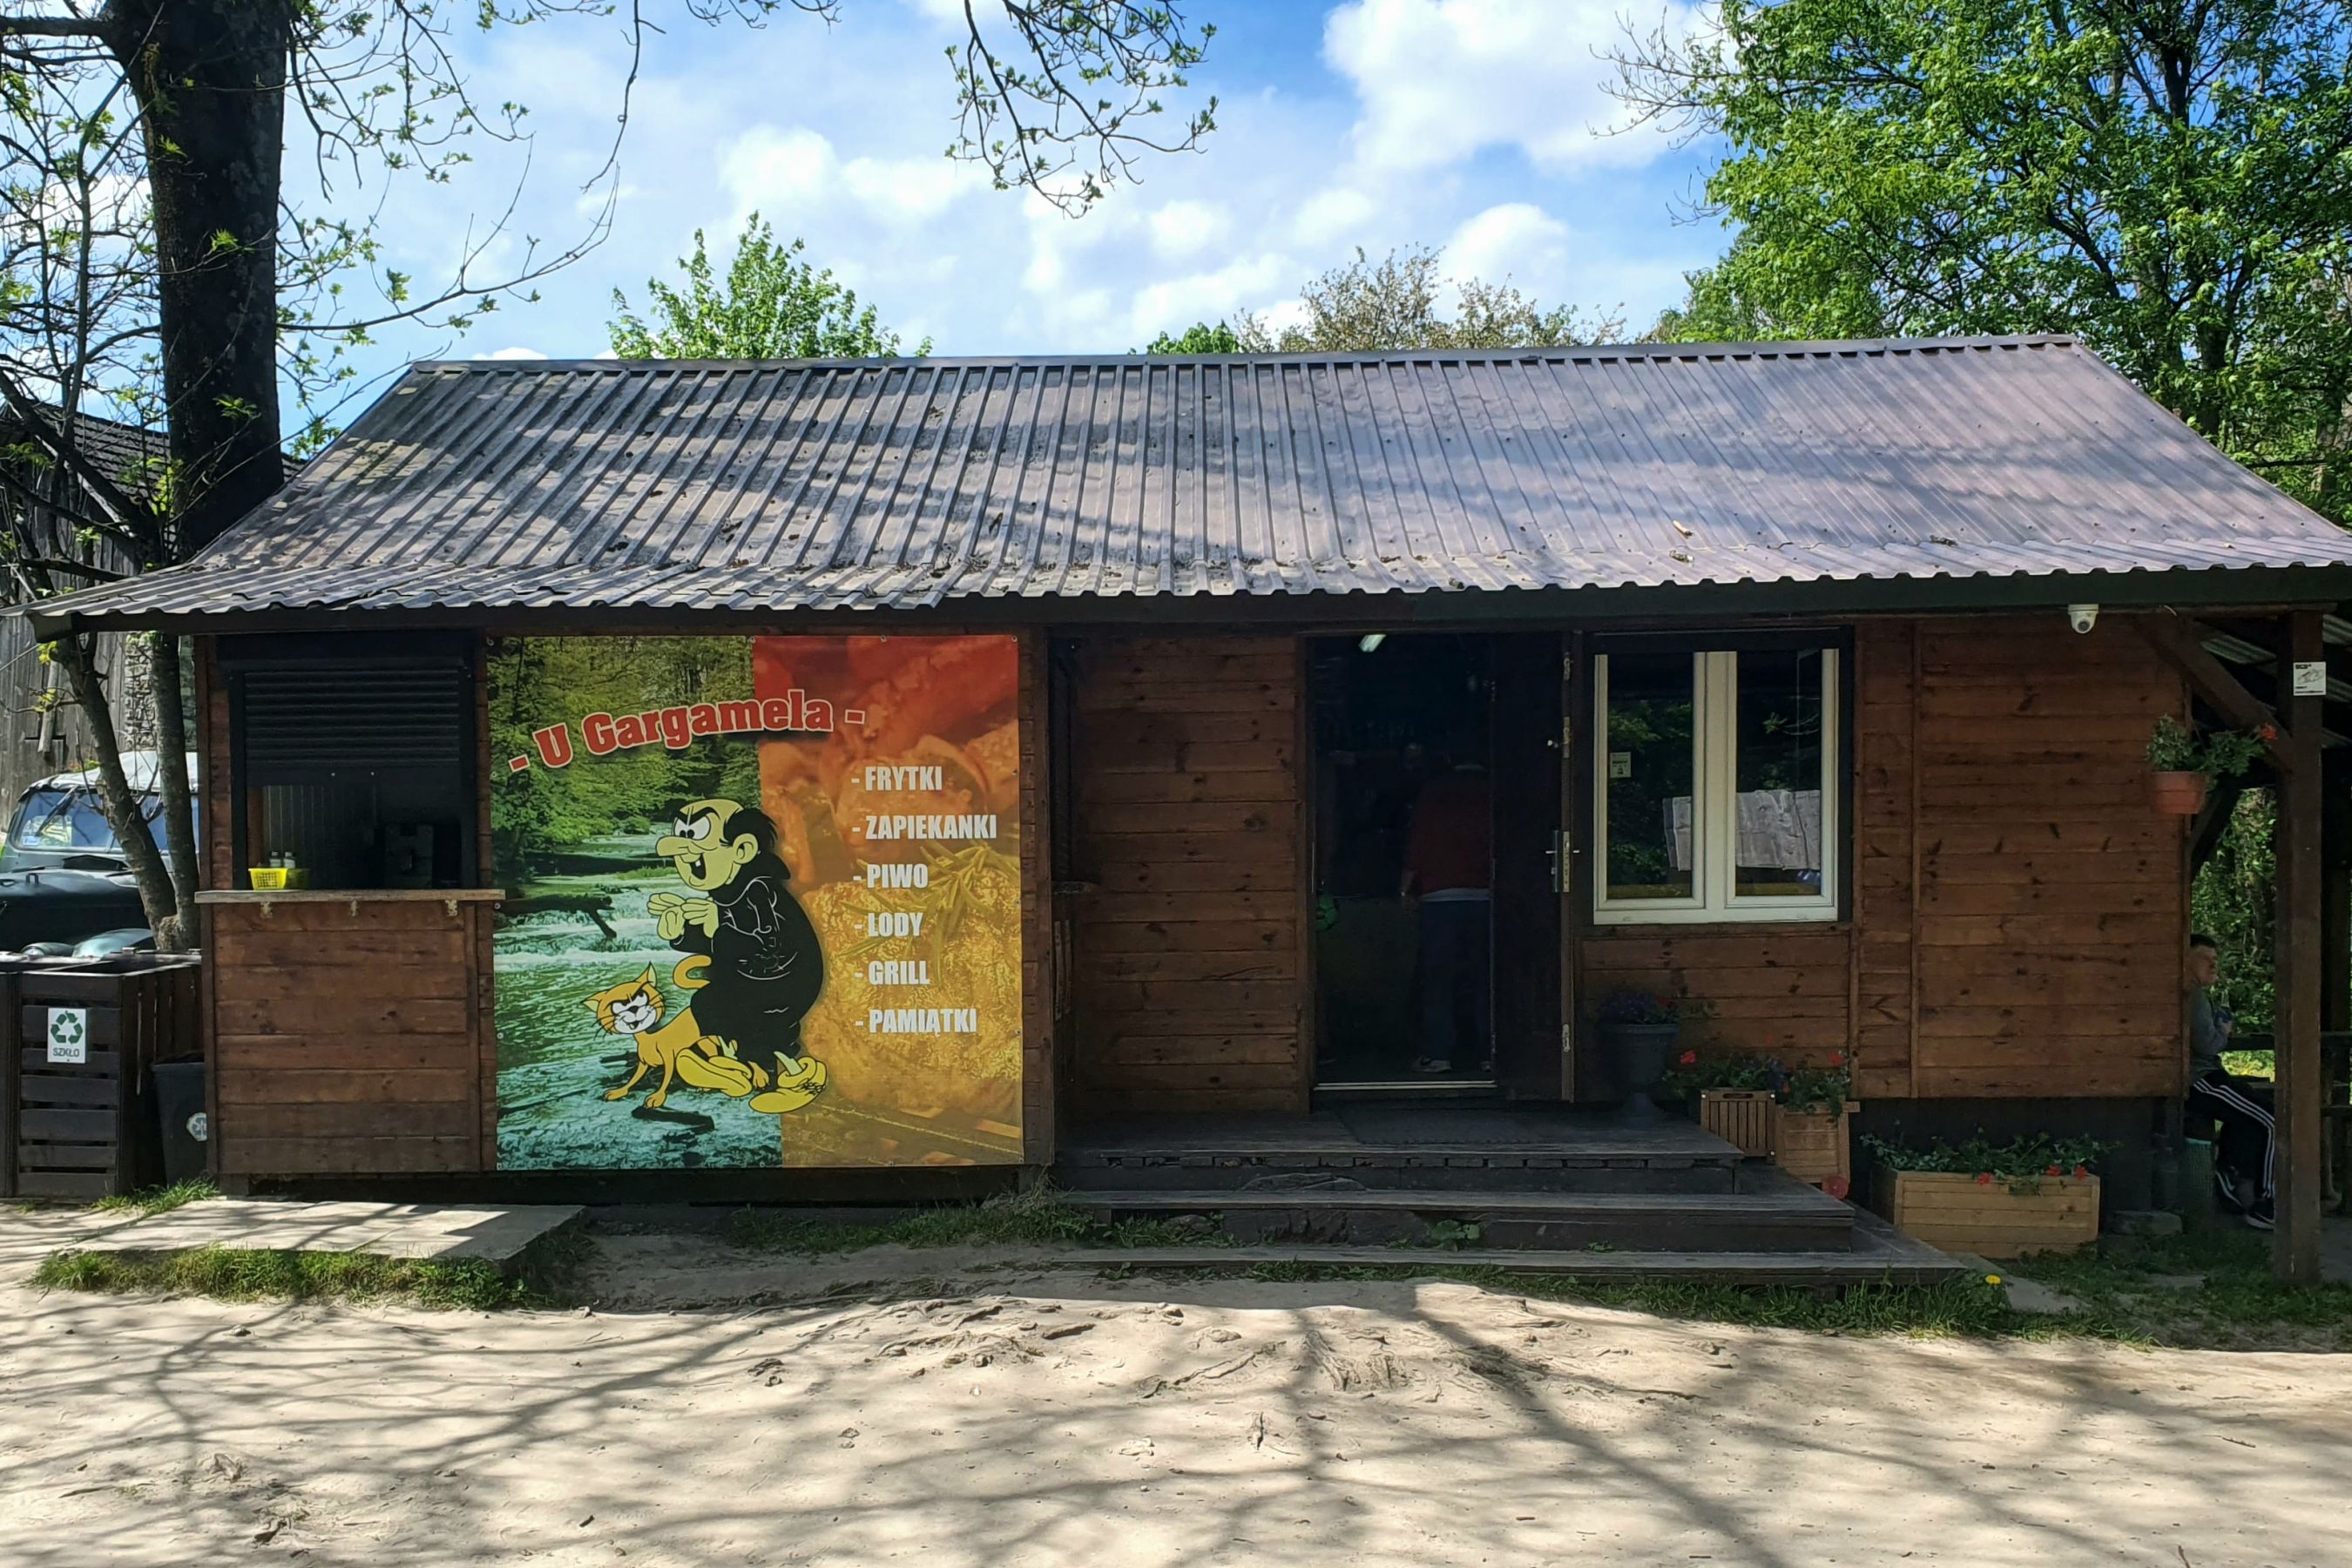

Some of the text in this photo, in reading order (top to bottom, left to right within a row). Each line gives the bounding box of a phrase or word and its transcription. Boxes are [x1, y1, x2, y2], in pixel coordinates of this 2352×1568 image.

[531, 722, 574, 768] U
[581, 689, 834, 750] Gargamela
[865, 766, 943, 791] FRYTKI
[865, 814, 997, 840] ZAPIEKANKI
[867, 863, 929, 889] PIWO
[868, 912, 923, 937] LODY
[868, 960, 930, 985] GRILL
[869, 1009, 977, 1037] PAMIĄTKI
[52, 1047, 80, 1058] SZKŁO
